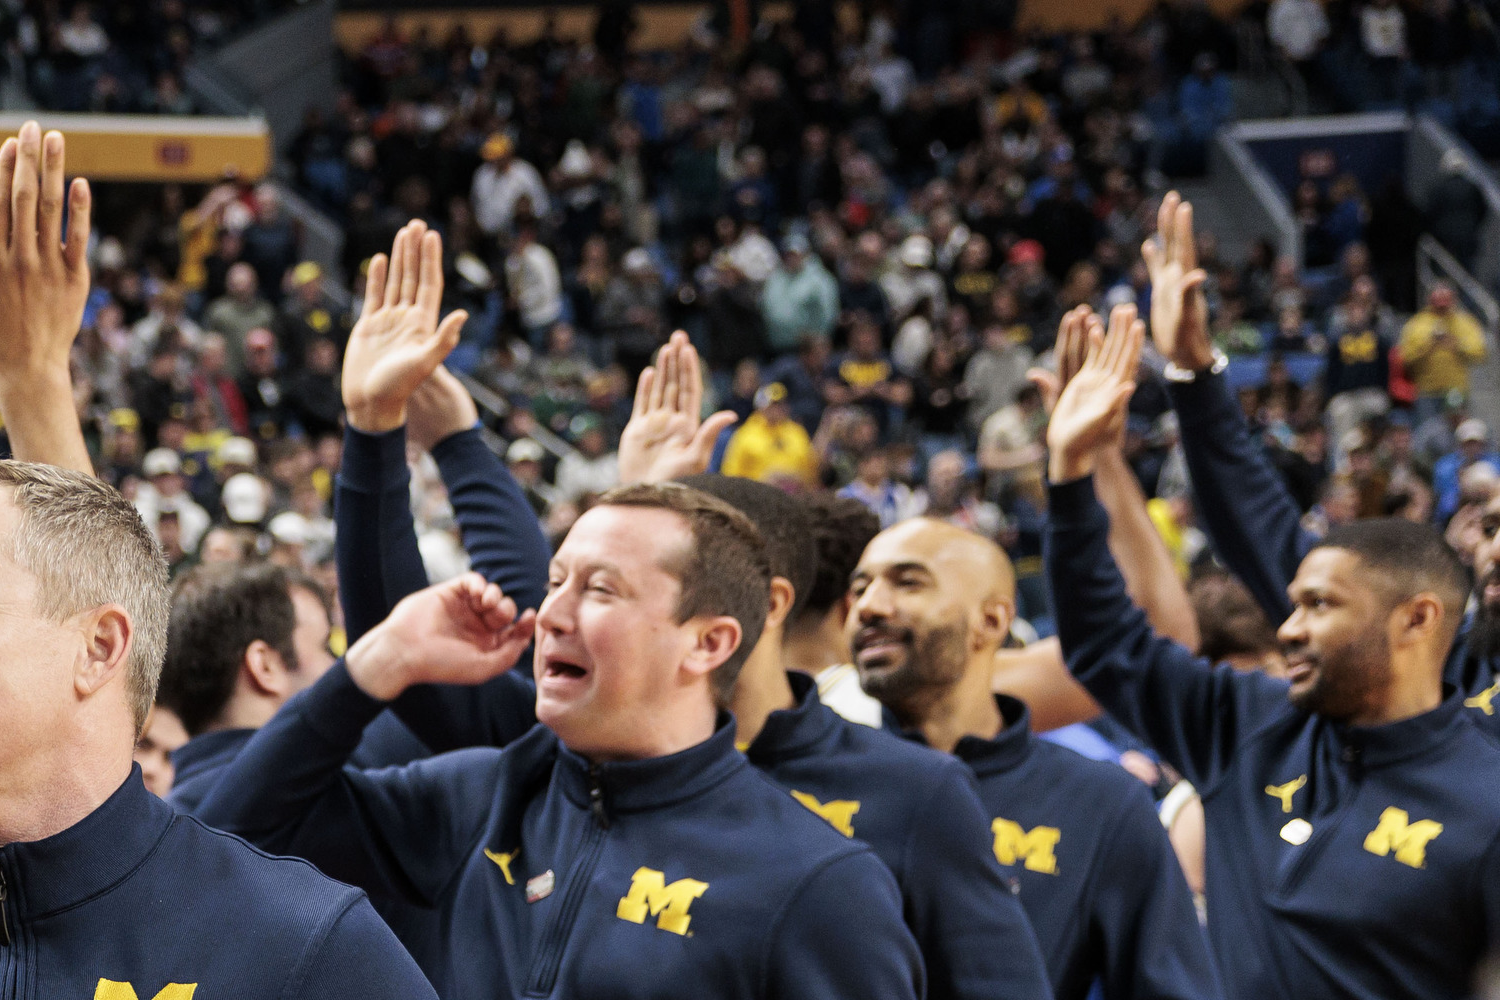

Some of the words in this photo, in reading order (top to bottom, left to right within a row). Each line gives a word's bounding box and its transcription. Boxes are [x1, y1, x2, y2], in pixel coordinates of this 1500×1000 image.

[991, 816, 1062, 875] M
[1363, 806, 1444, 869] M
[616, 866, 710, 936] M
